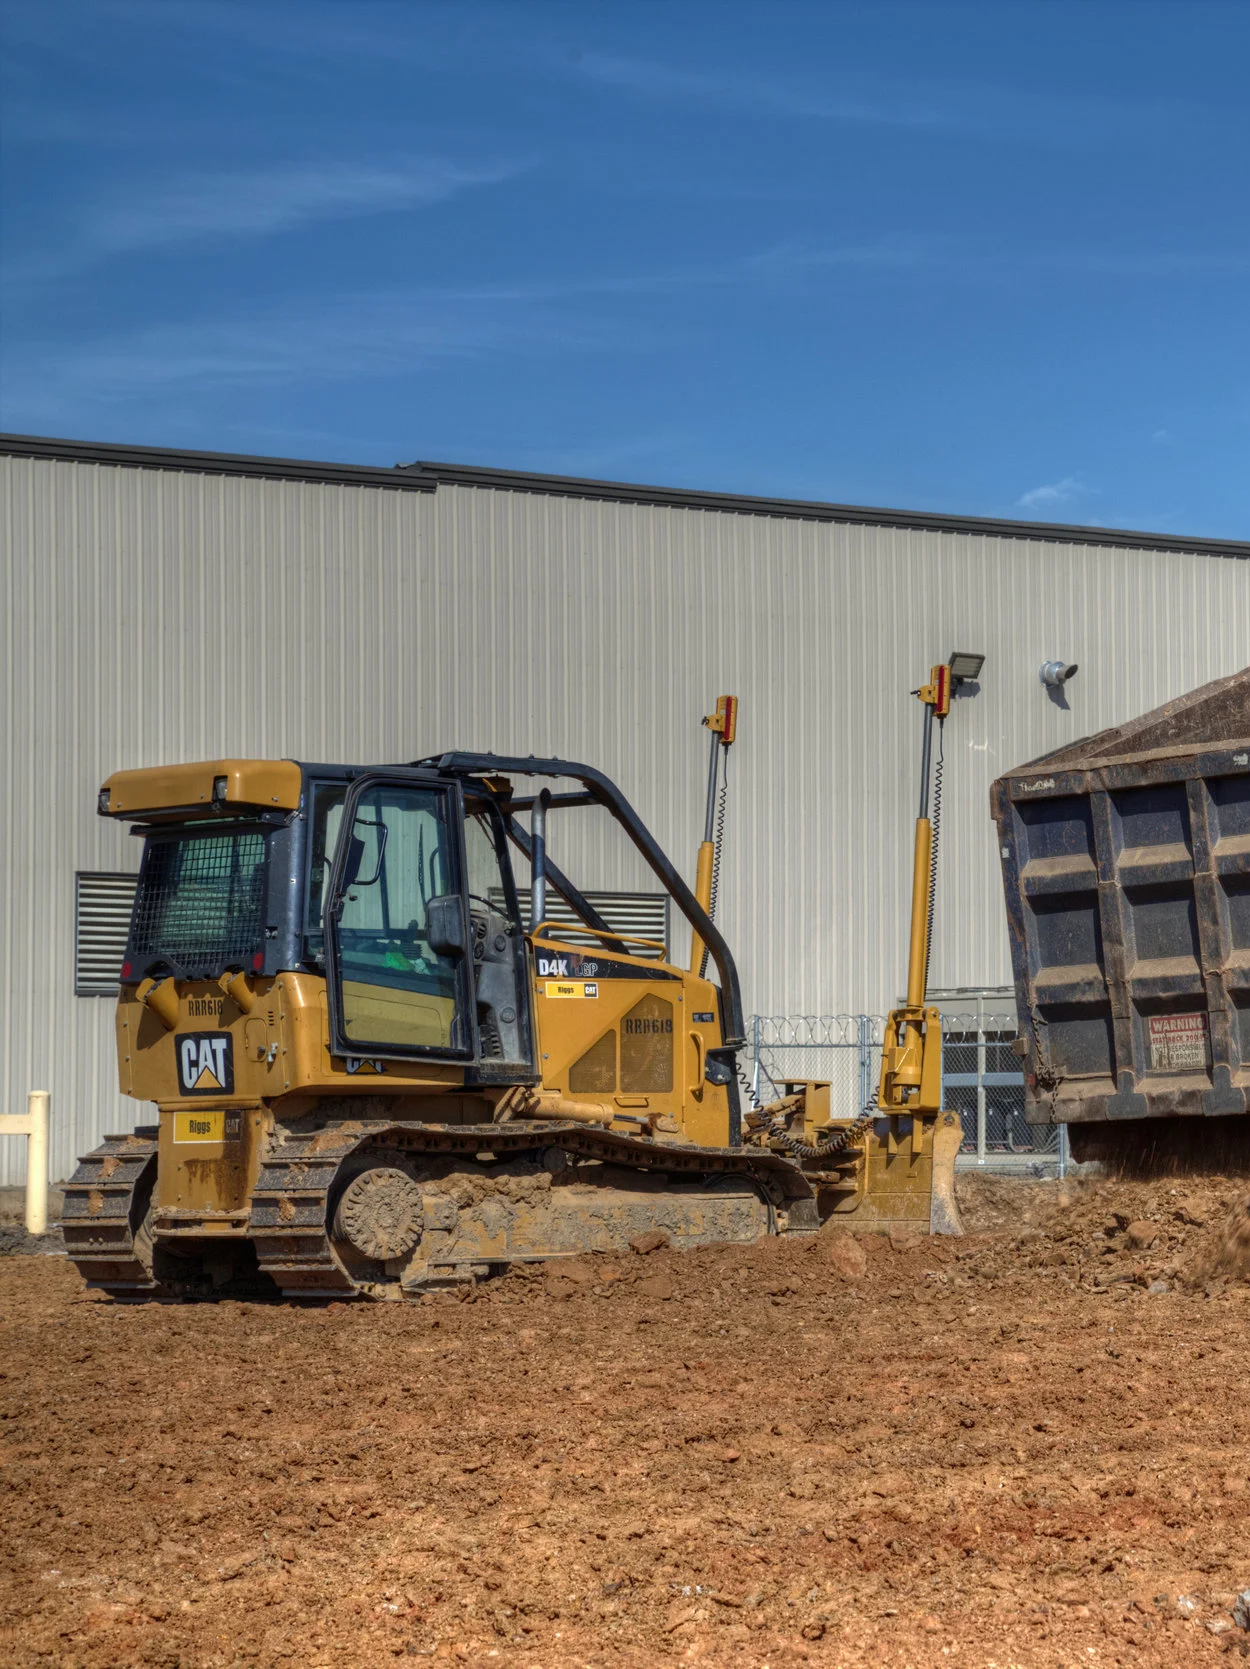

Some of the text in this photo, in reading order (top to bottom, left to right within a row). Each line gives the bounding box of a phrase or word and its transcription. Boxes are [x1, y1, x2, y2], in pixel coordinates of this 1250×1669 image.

[539, 959, 568, 976] D4K
[557, 986, 597, 995] Riggs CAT
[188, 1000, 223, 1017] RRR618
[625, 1018, 673, 1034] RRR618
[1152, 1017, 1203, 1033] WARNING
[181, 1038, 227, 1089] CAT
[189, 1118, 240, 1134] Riggs CAT
